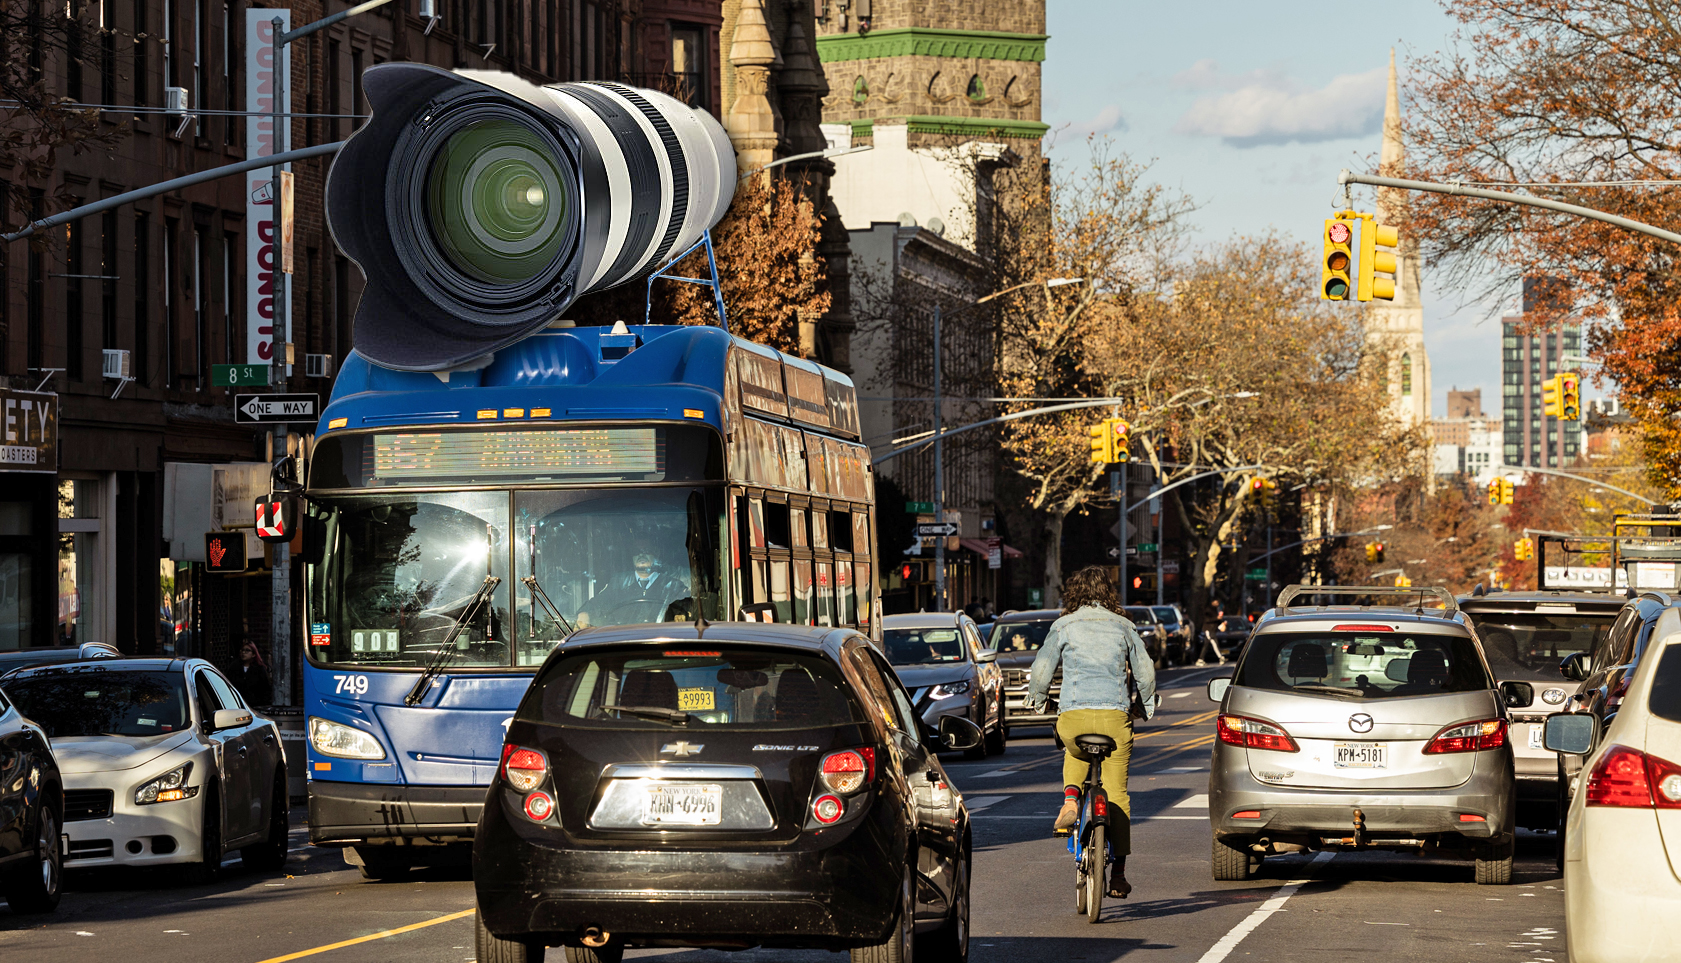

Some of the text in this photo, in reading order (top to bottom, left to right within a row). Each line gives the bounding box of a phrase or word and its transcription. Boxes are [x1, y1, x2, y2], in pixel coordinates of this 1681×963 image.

[229, 367, 253, 384] 8 St
[248, 402, 308, 414] ONE WAY
[1, 447, 36, 462] OASTERS
[920, 526, 935, 534] ONE
[354, 631, 398, 651] 908
[333, 674, 369, 695] 749
[752, 744, 796, 752] SONIC
[1337, 748, 1382, 763] KPM 5181
